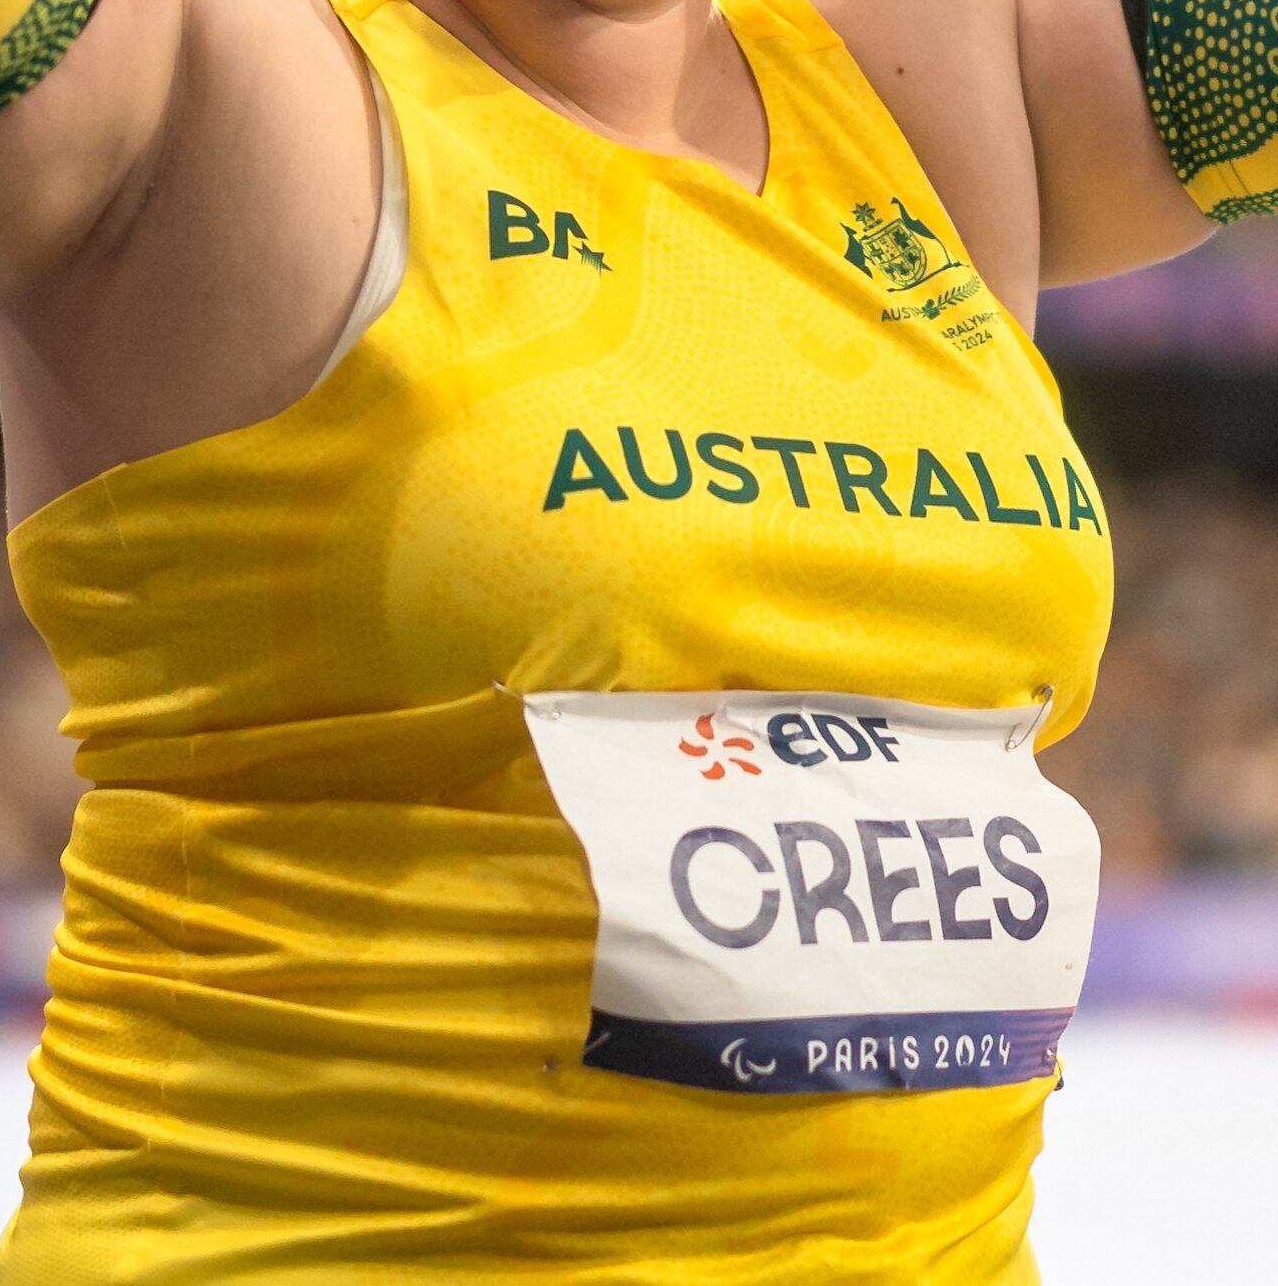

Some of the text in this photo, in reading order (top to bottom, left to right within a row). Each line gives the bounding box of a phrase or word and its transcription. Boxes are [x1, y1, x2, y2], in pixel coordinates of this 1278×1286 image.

[961, 329, 994, 351] 2024
[542, 425, 1103, 537] AUSTRALIA
[669, 815, 1050, 950] CREES
[807, 1033, 1011, 1074] PARIS 2024
